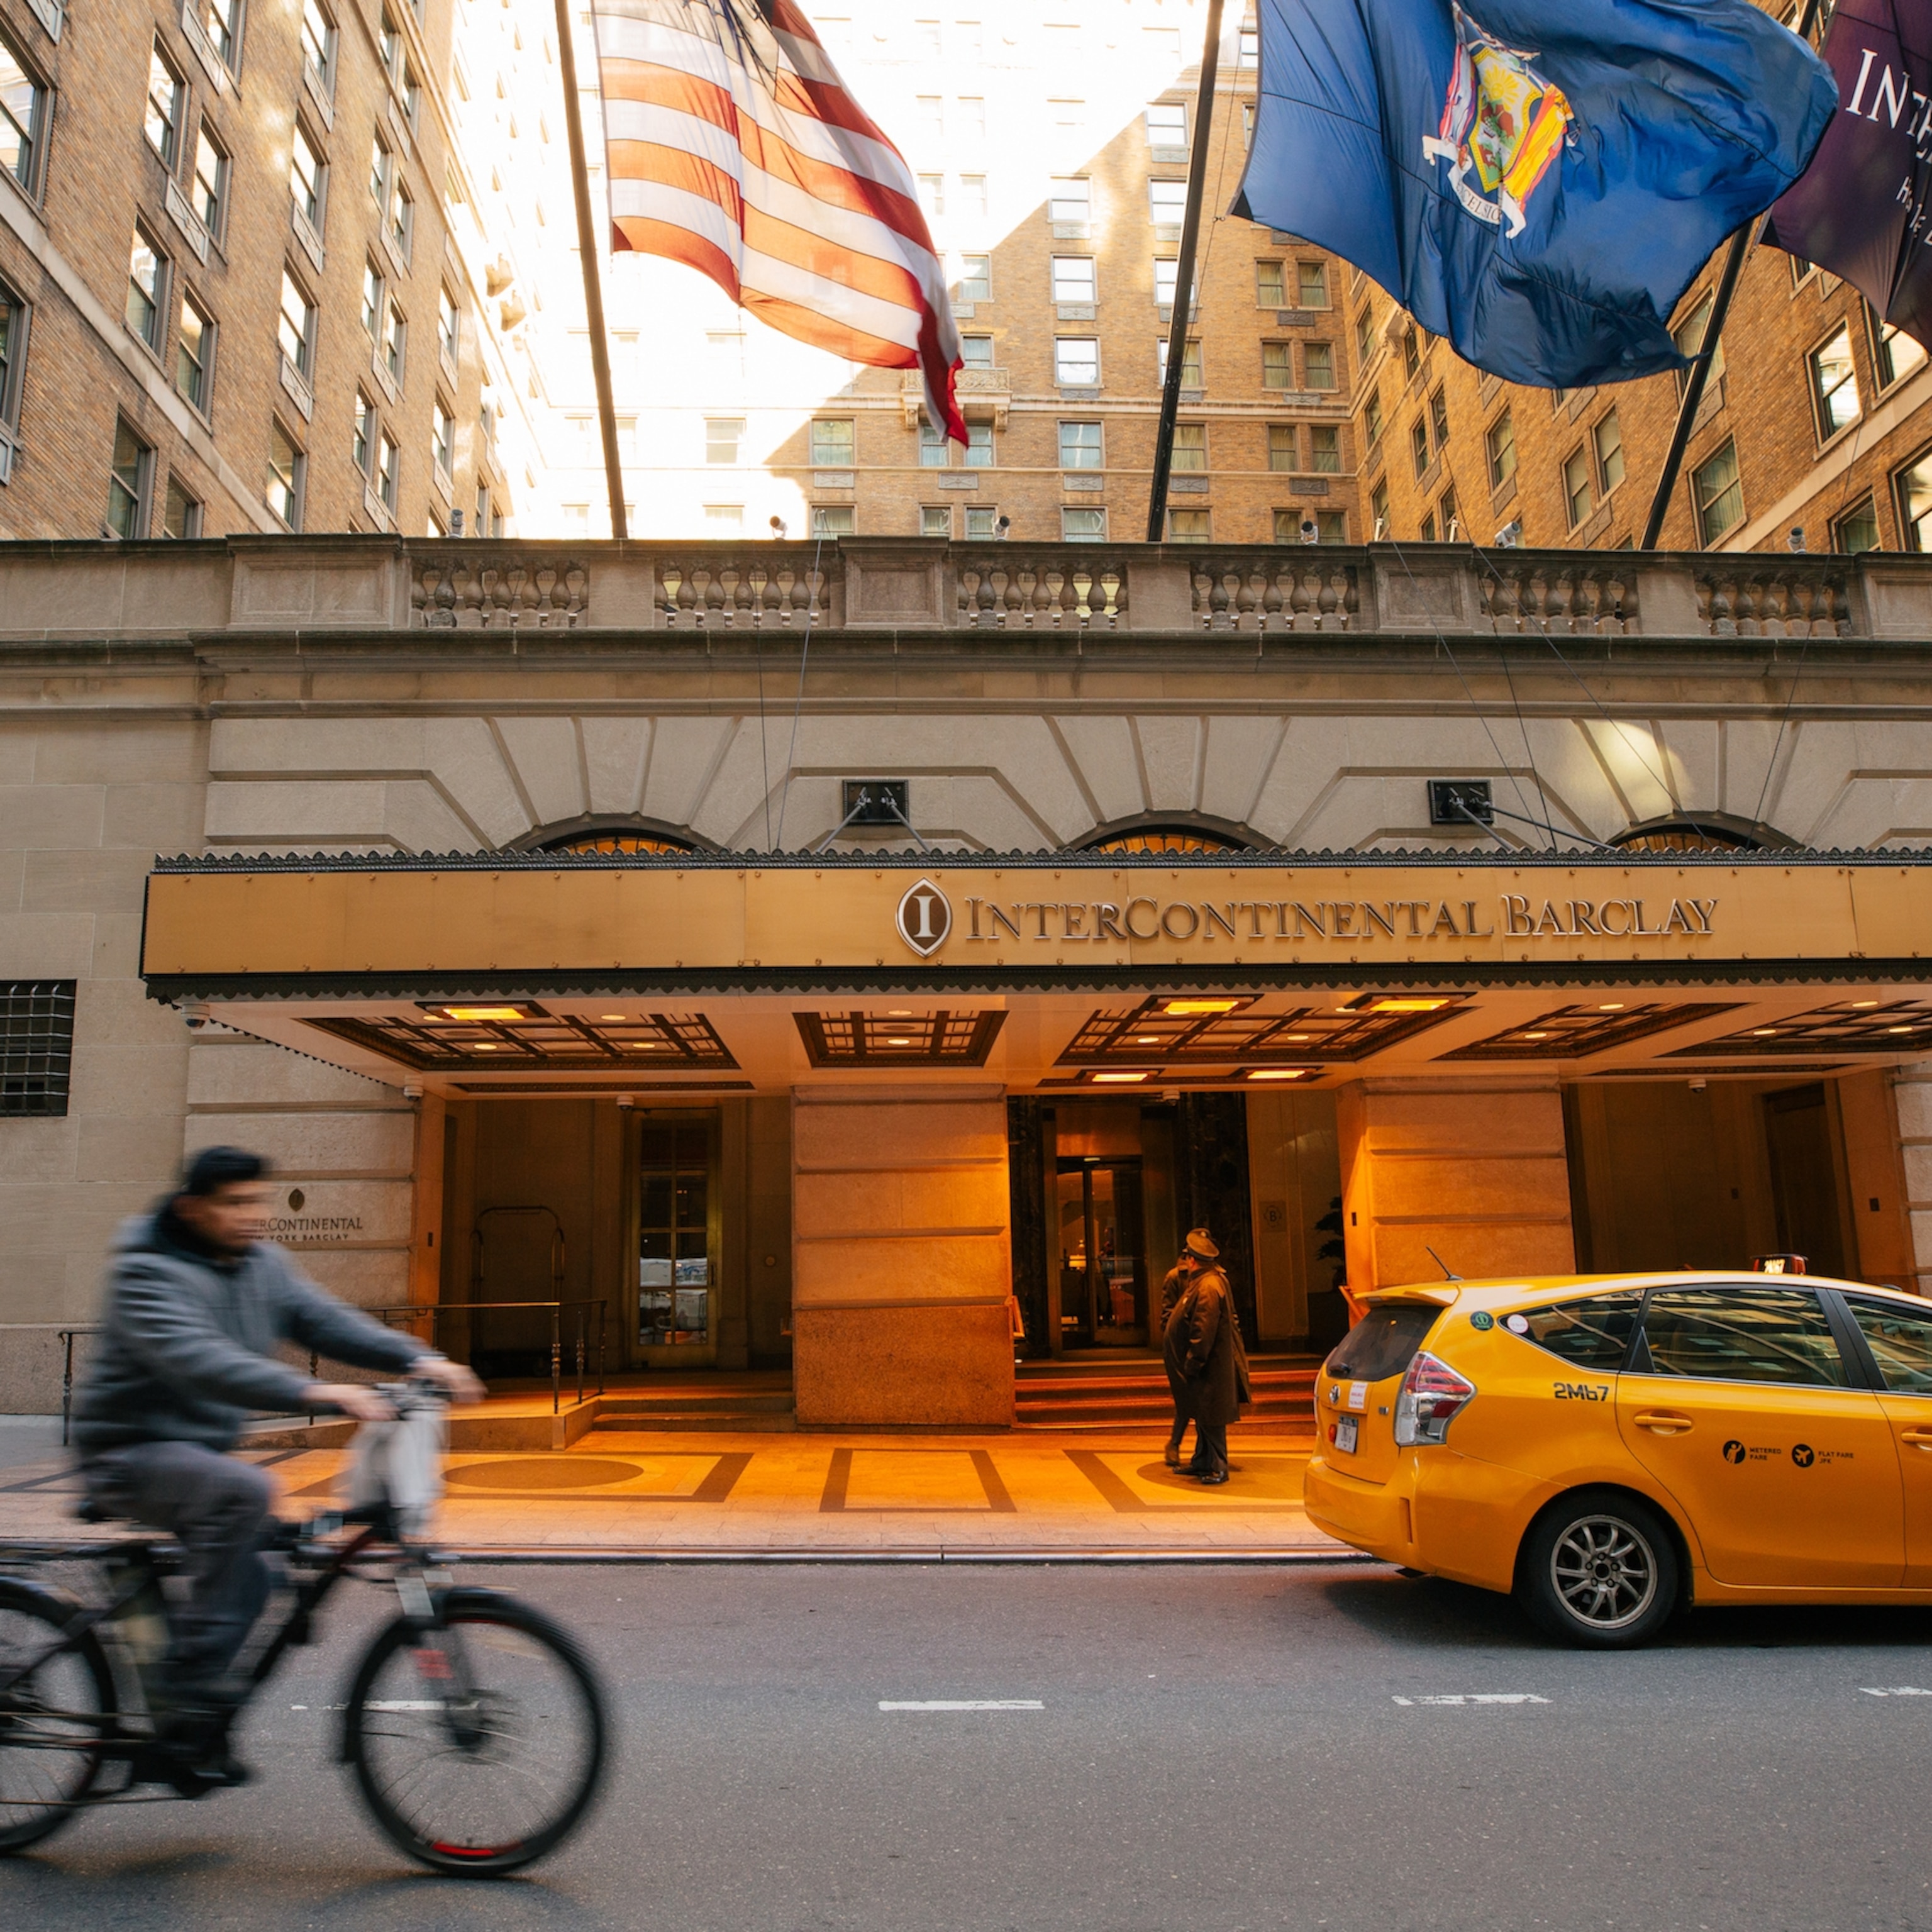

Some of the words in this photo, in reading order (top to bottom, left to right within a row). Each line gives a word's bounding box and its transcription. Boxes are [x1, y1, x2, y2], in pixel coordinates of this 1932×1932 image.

[965, 896, 1494, 940] INTERCONTINENTAL
[1501, 894, 1719, 936] BARCLAY
[303, 1233, 349, 1241] BARCLAY
